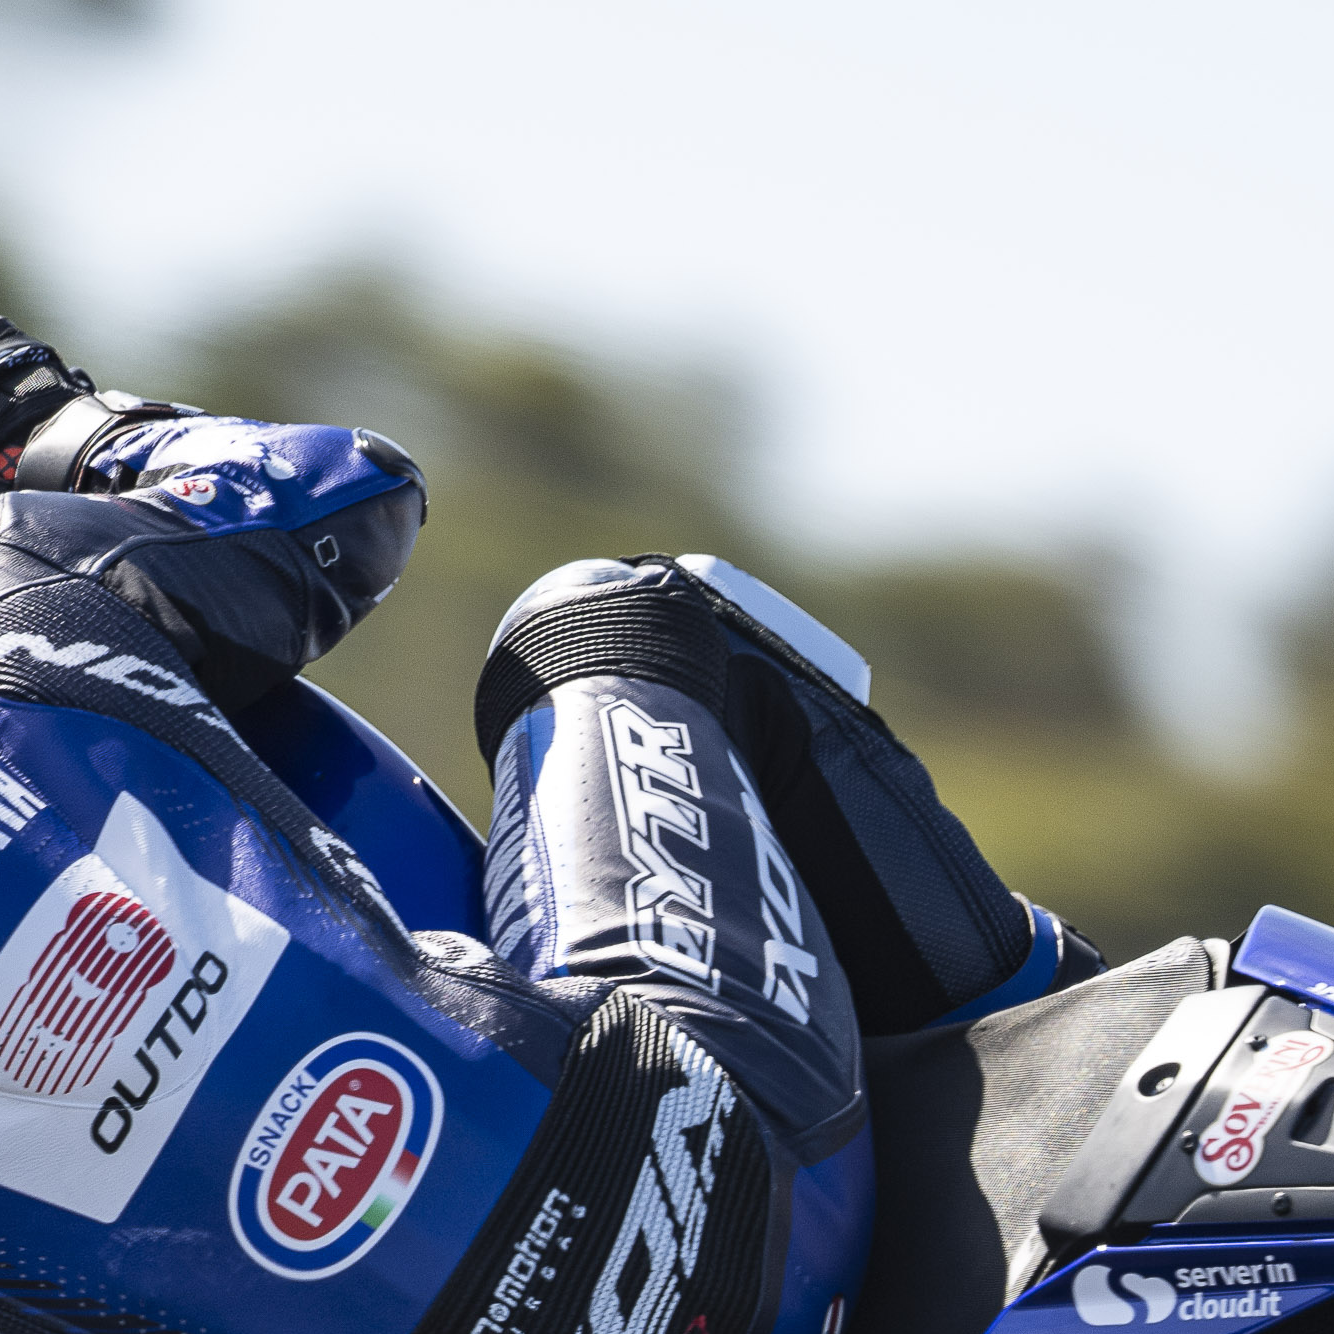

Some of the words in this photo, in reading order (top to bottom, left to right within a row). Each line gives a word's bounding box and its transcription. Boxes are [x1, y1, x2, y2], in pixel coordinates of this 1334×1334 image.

[599, 700, 721, 995] GYTR
[91, 951, 227, 1154] OUTDO
[250, 1075, 316, 1166] SNACK
[275, 1094, 394, 1228] PATA
[1178, 1288, 1282, 1321] cloud.it
